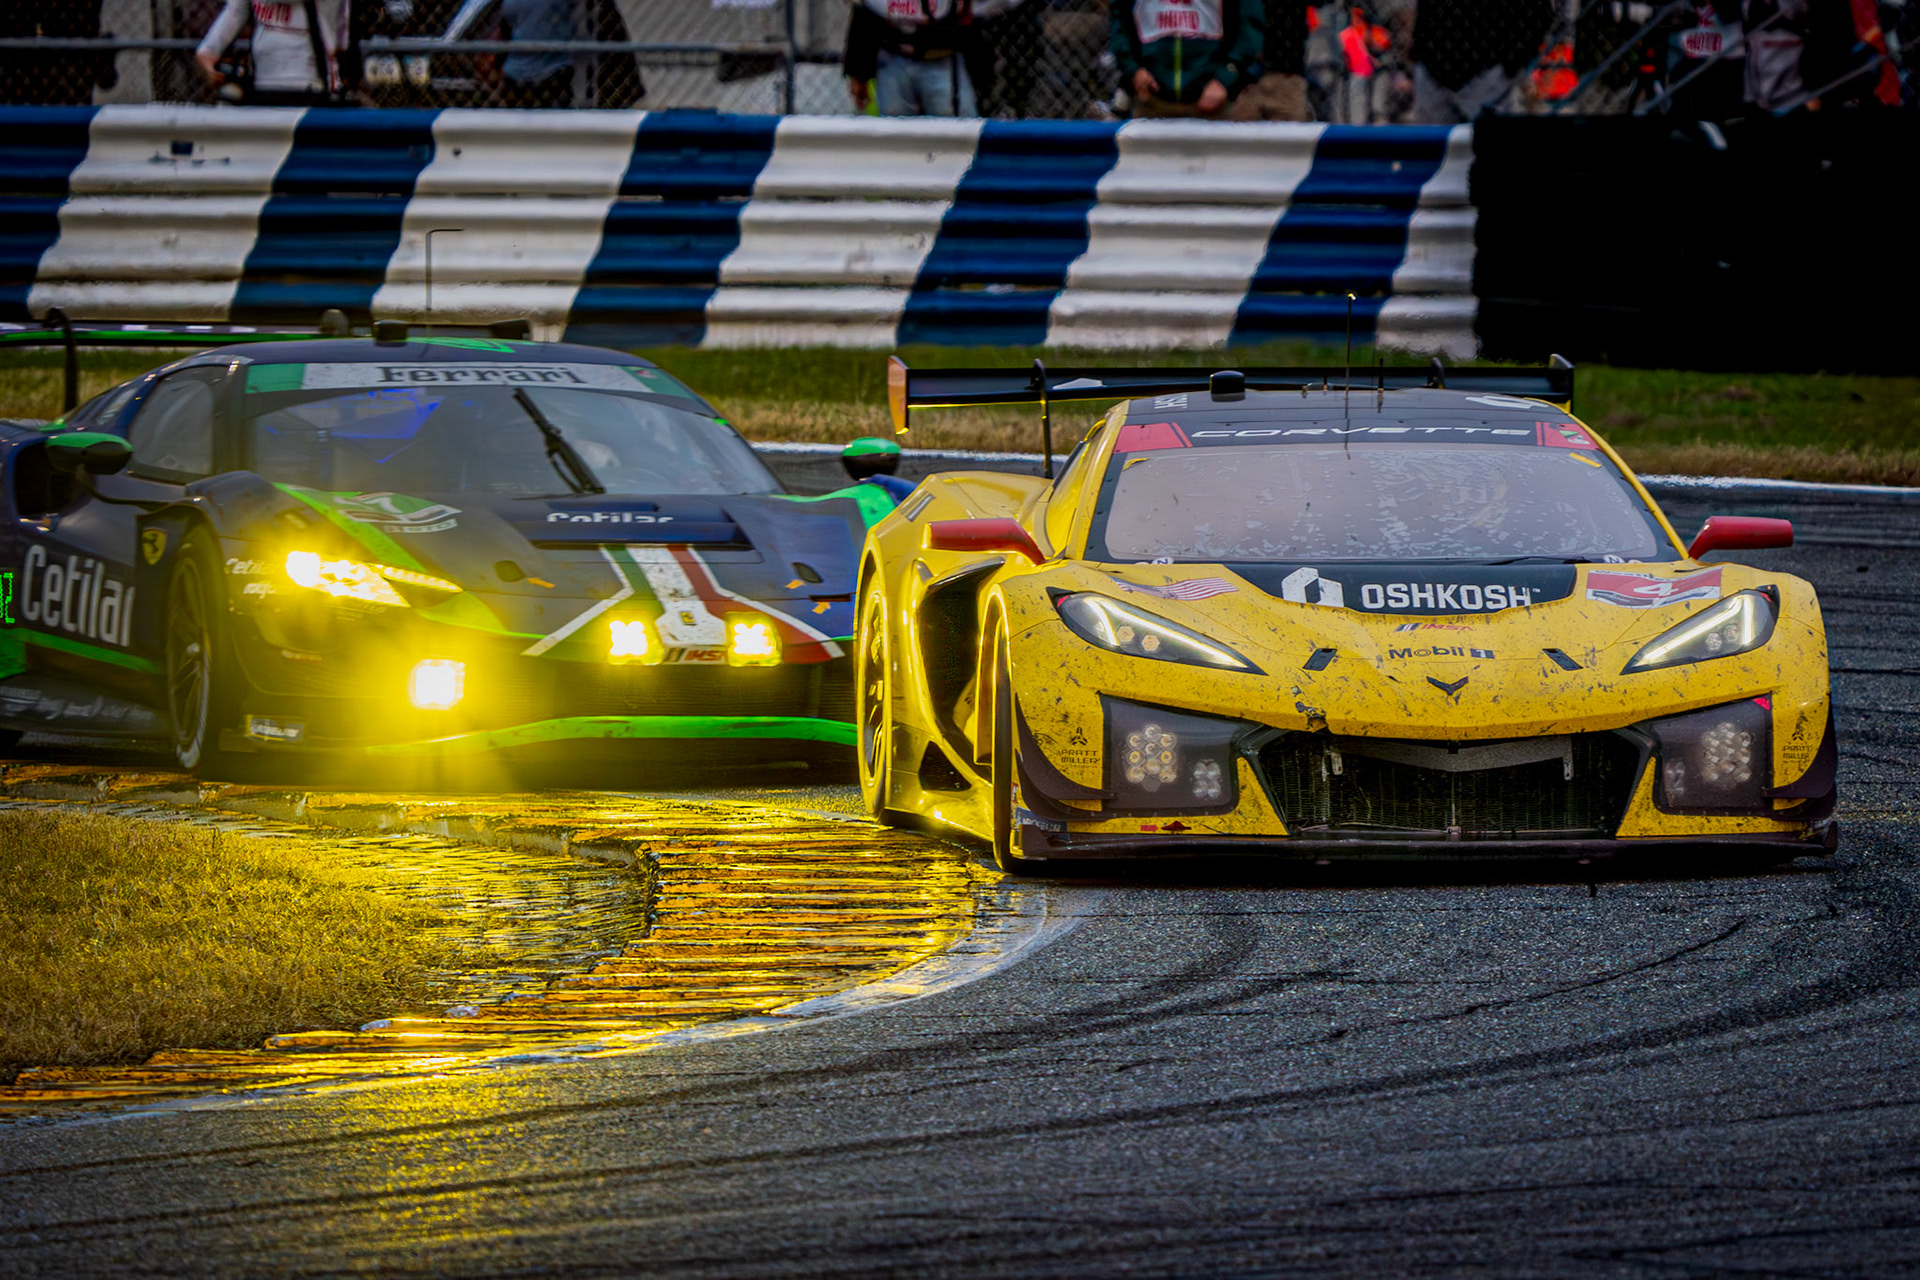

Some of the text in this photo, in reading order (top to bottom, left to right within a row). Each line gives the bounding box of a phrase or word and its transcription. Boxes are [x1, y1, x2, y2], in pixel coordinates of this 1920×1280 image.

[376, 366, 588, 384] Ferrari
[1191, 427, 1531, 438] CORVETTE
[1633, 582, 1679, 596] 4
[1361, 583, 1532, 610] OSHKOSH
[1421, 623, 1474, 631] IMSA
[1388, 646, 1465, 659] Mobil
